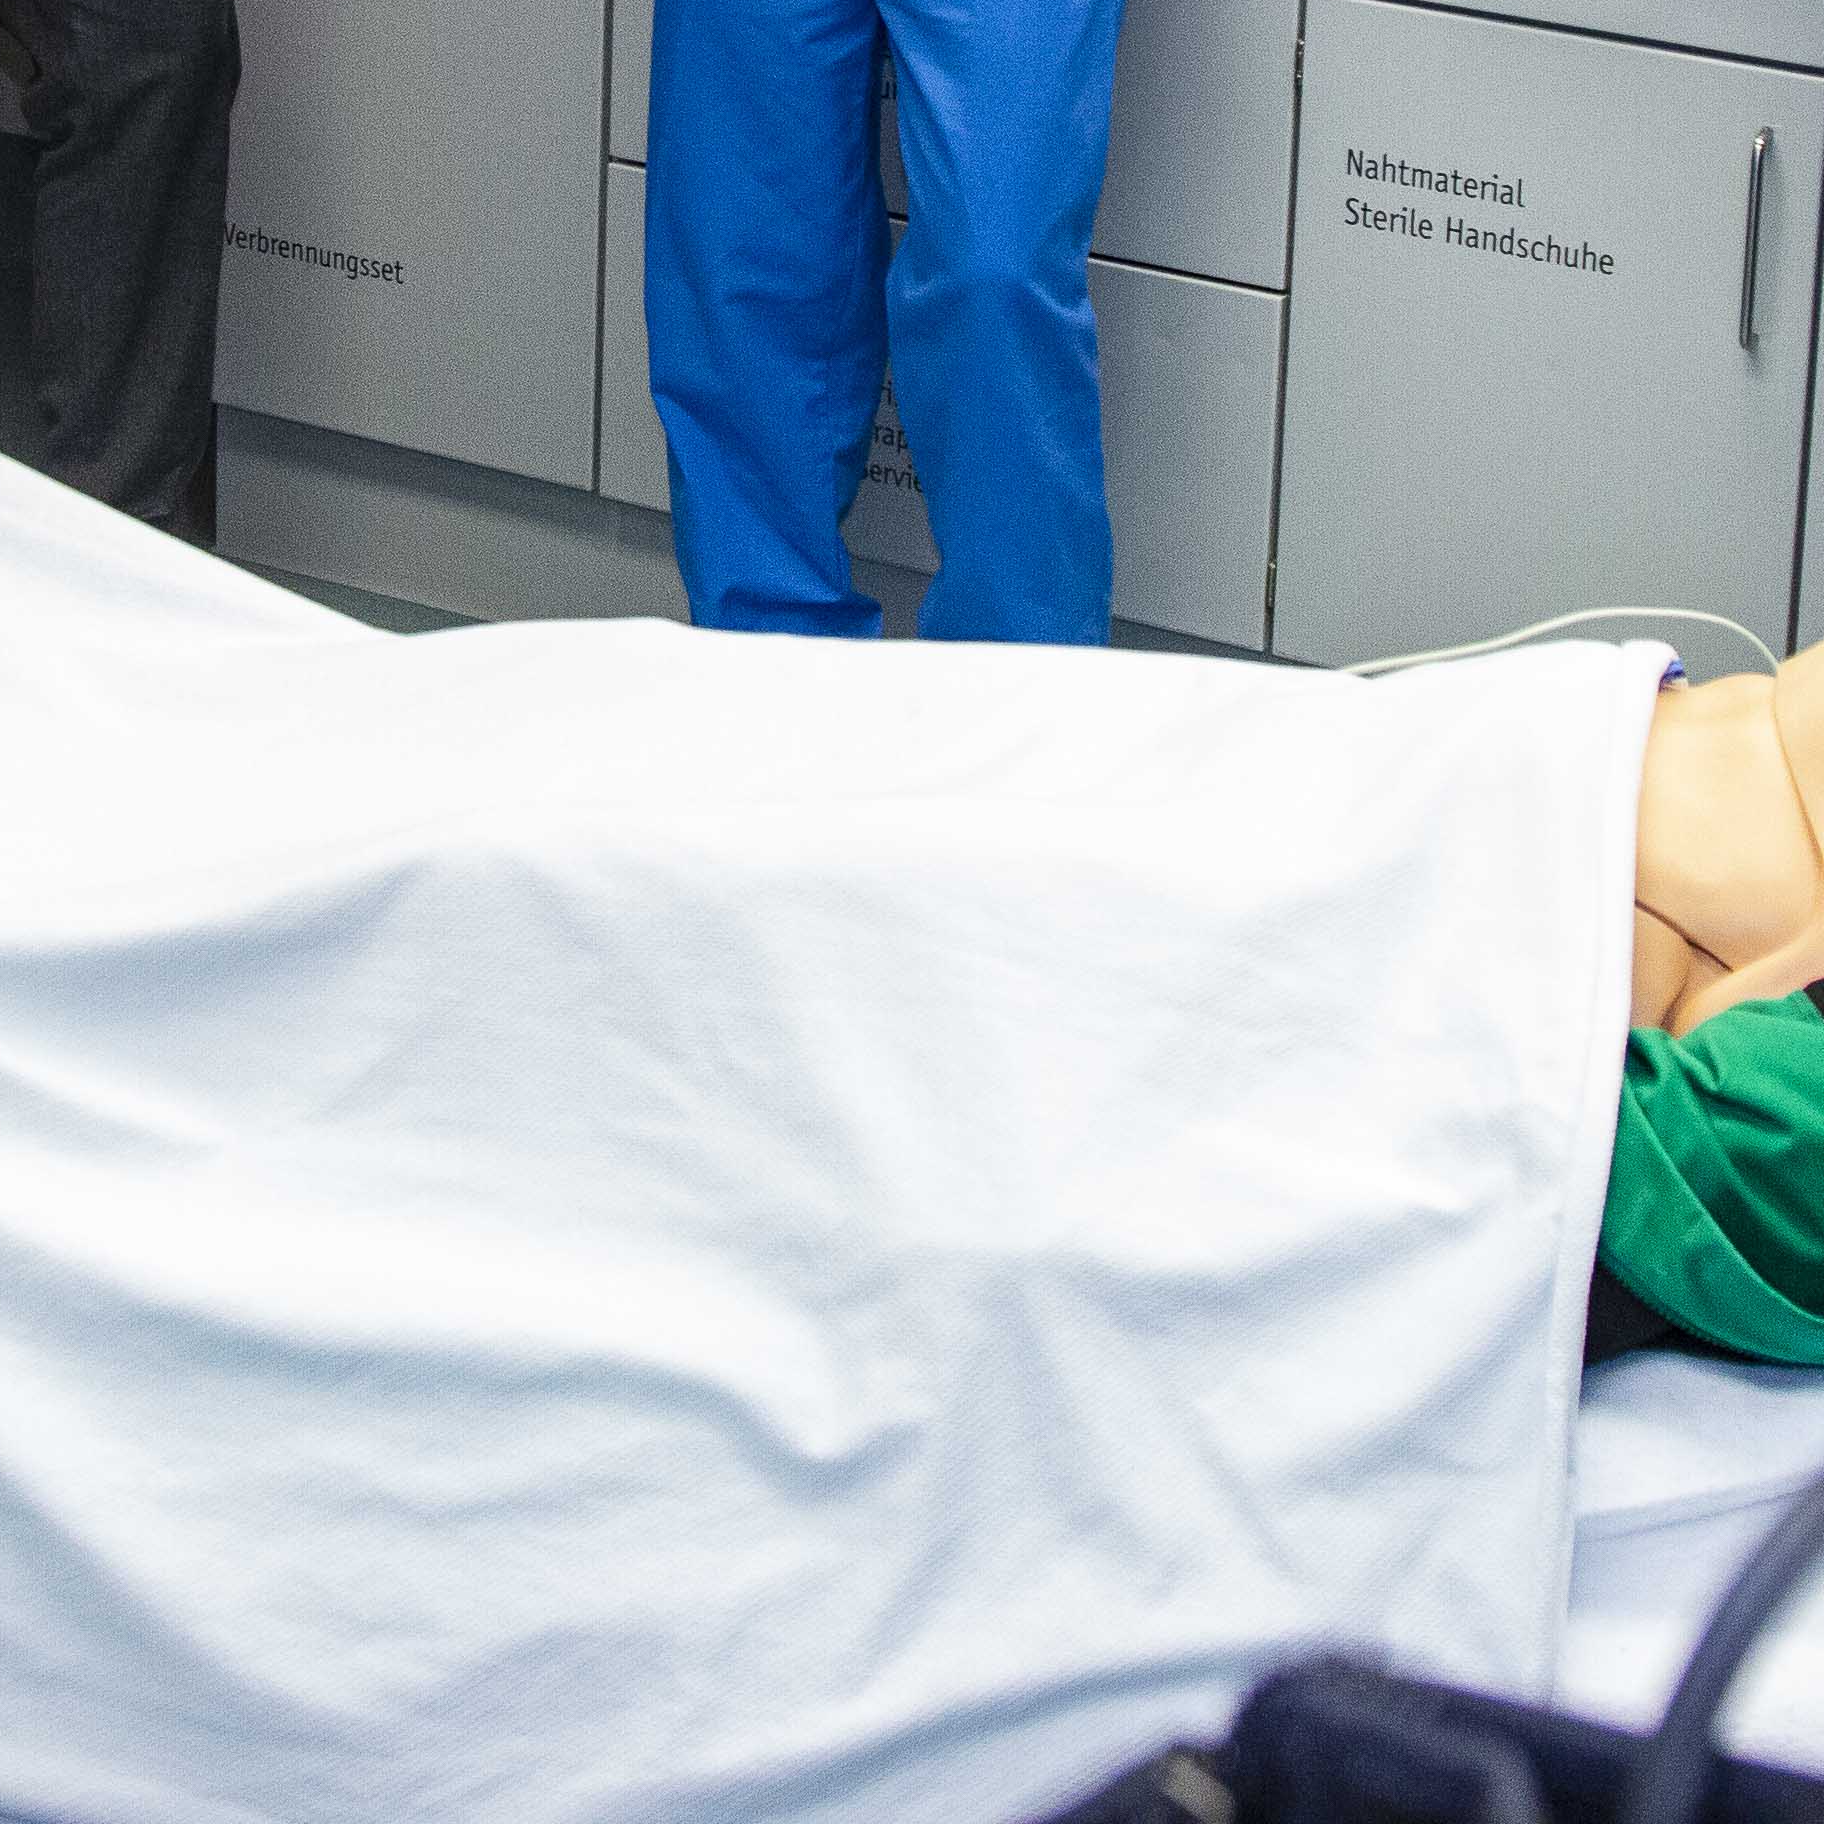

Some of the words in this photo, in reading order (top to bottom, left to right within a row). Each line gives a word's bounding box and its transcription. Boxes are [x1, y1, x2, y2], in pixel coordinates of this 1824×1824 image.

[1346, 148, 1526, 208] Nahtmaterial
[225, 223, 404, 285] Verbrennungsset
[1344, 198, 1434, 239] Sterile
[1445, 216, 1616, 274] Handschuhe
